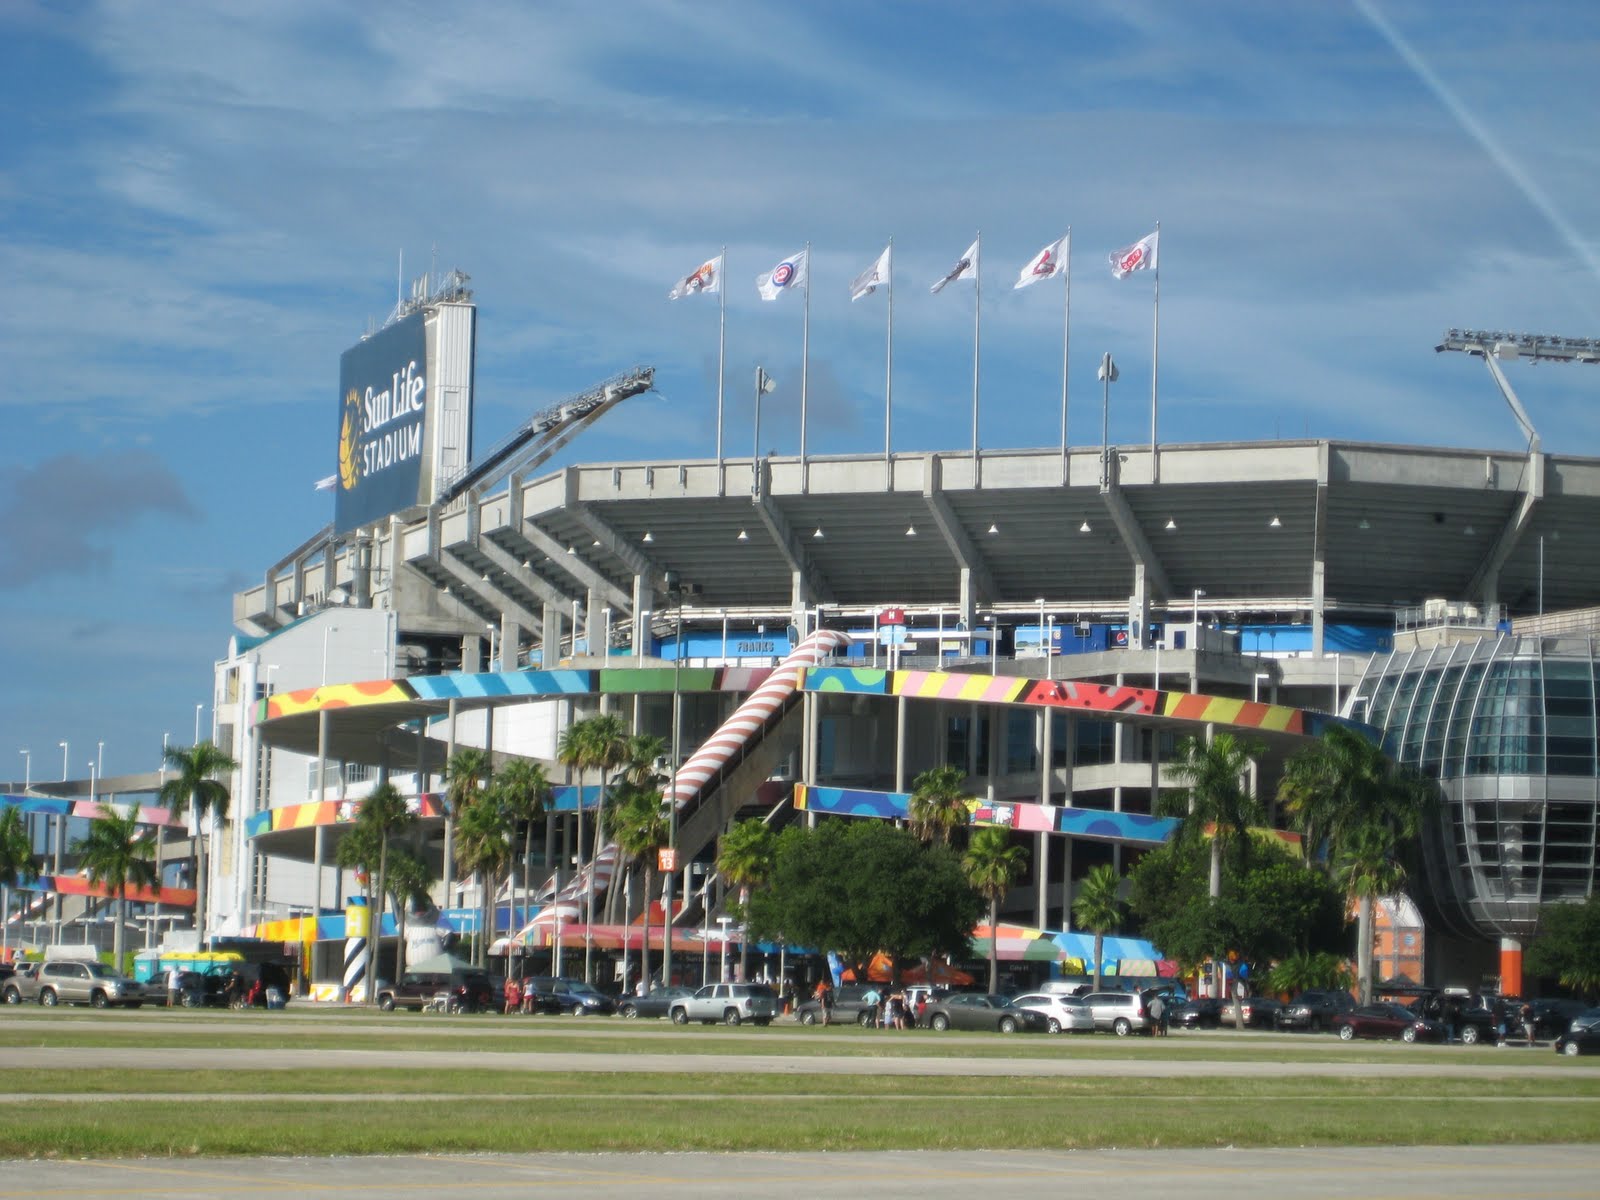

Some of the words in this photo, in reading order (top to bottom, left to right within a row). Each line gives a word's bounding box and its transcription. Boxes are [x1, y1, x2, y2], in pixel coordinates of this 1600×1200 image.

[364, 386, 390, 433] Sun
[392, 361, 424, 420] Life
[363, 422, 421, 477] STADIUM
[888, 611, 895, 619] H
[659, 850, 675, 858] WEST
[661, 858, 673, 869] 13
[347, 912, 361, 936] H
